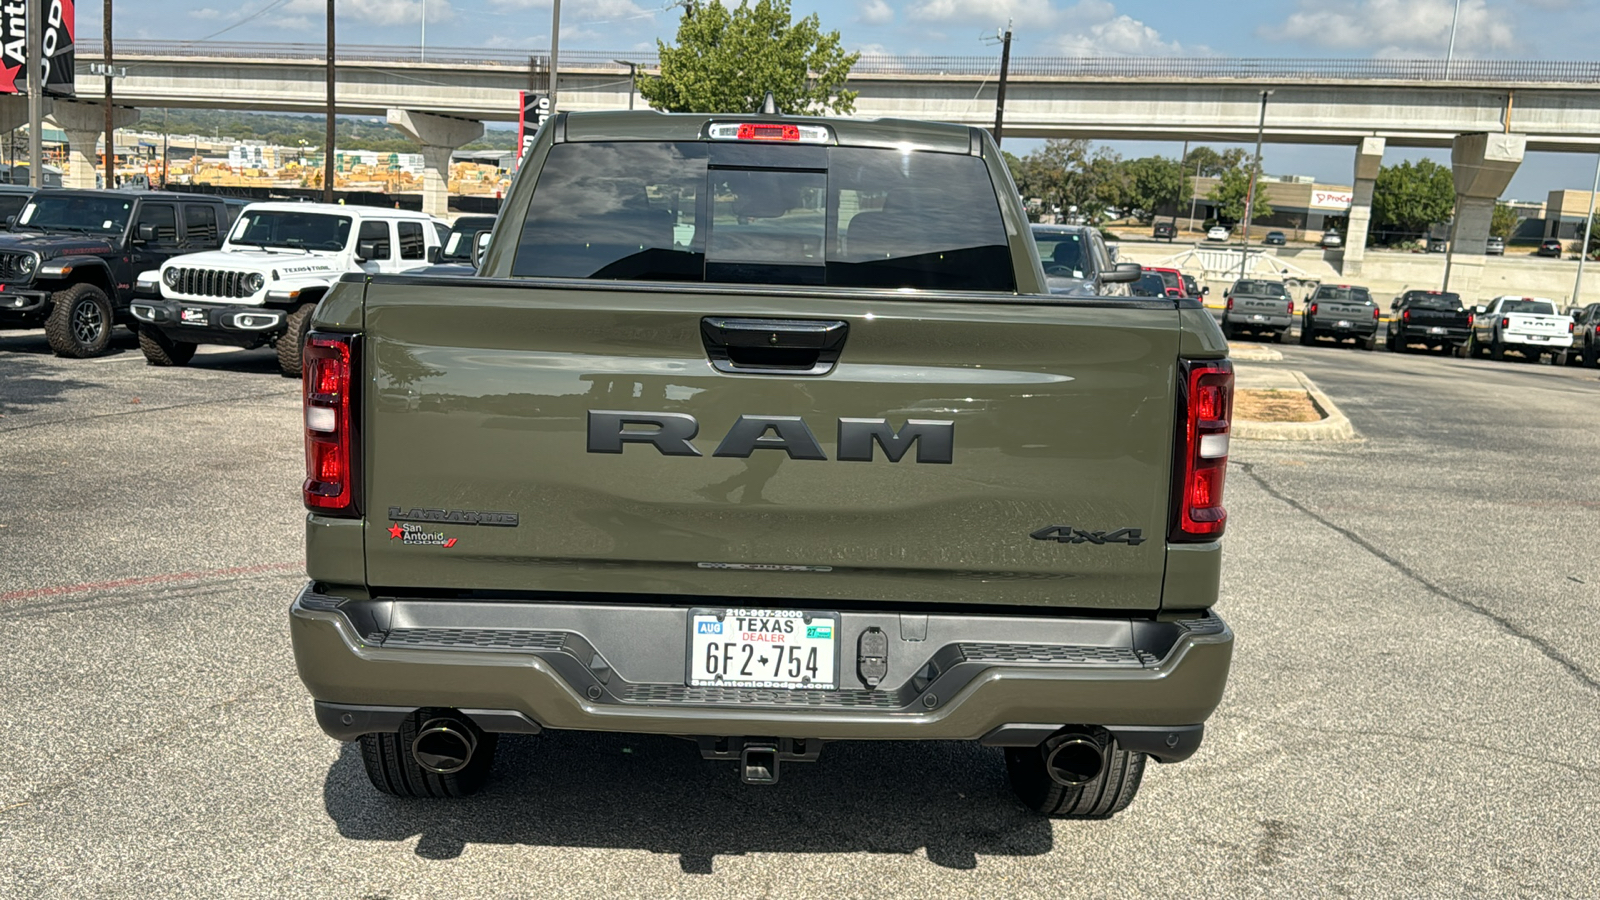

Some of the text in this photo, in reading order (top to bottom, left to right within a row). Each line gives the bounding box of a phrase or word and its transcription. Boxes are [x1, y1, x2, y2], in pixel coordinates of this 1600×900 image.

[4, 0, 26, 64] Ant
[282, 266, 308, 274] TEXAS
[587, 408, 955, 465] RAM
[388, 506, 519, 527] LARAMIE
[402, 523, 422, 533] San
[403, 532, 445, 541] Antonio
[1029, 525, 1147, 546] 4x4
[700, 623, 721, 633] AUG
[735, 617, 795, 634] TEXAS
[742, 632, 785, 643] DEALER
[807, 627, 816, 637] 27
[691, 679, 834, 690] SanAntonioDodge.com
